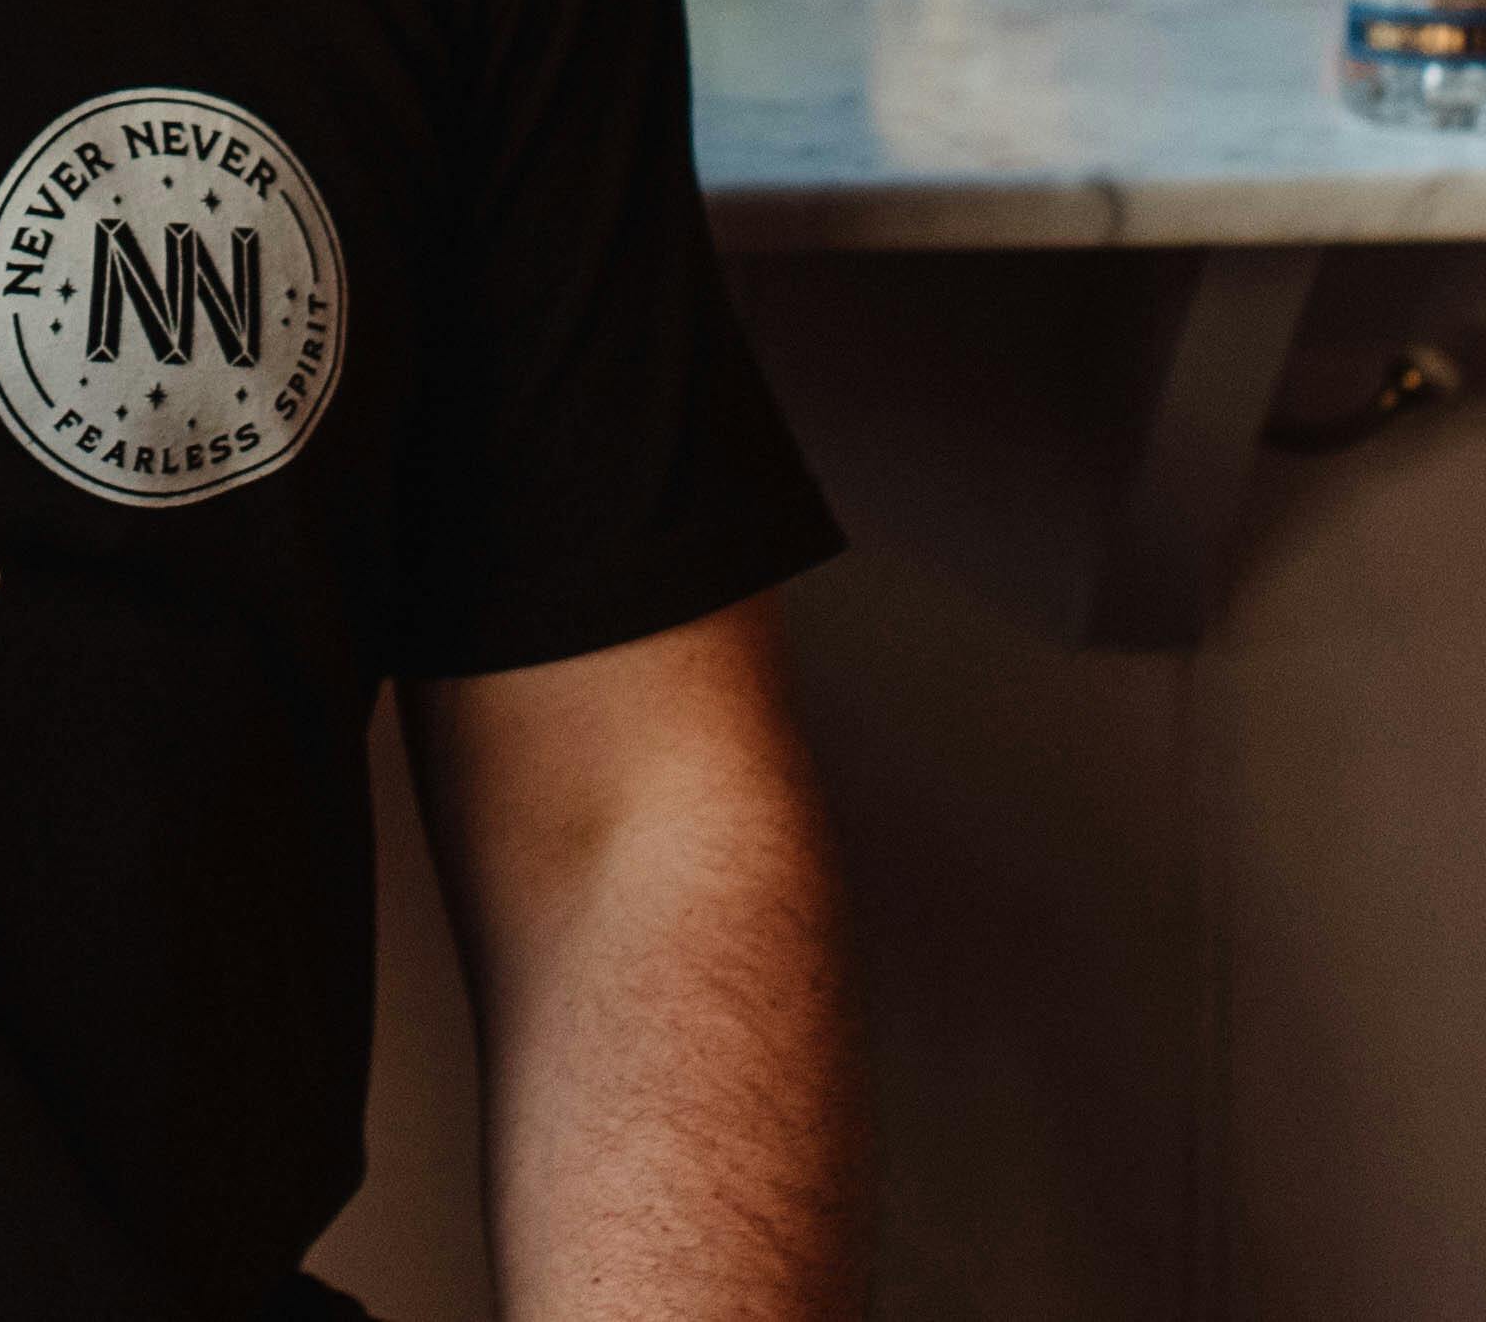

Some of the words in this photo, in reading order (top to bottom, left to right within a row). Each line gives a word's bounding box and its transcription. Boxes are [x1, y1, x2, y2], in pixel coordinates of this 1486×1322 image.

[3, 141, 115, 298] NEVER
[121, 121, 282, 201] NEVER
[54, 409, 262, 475] FEARLESS
[275, 292, 330, 422] SPIRIT
